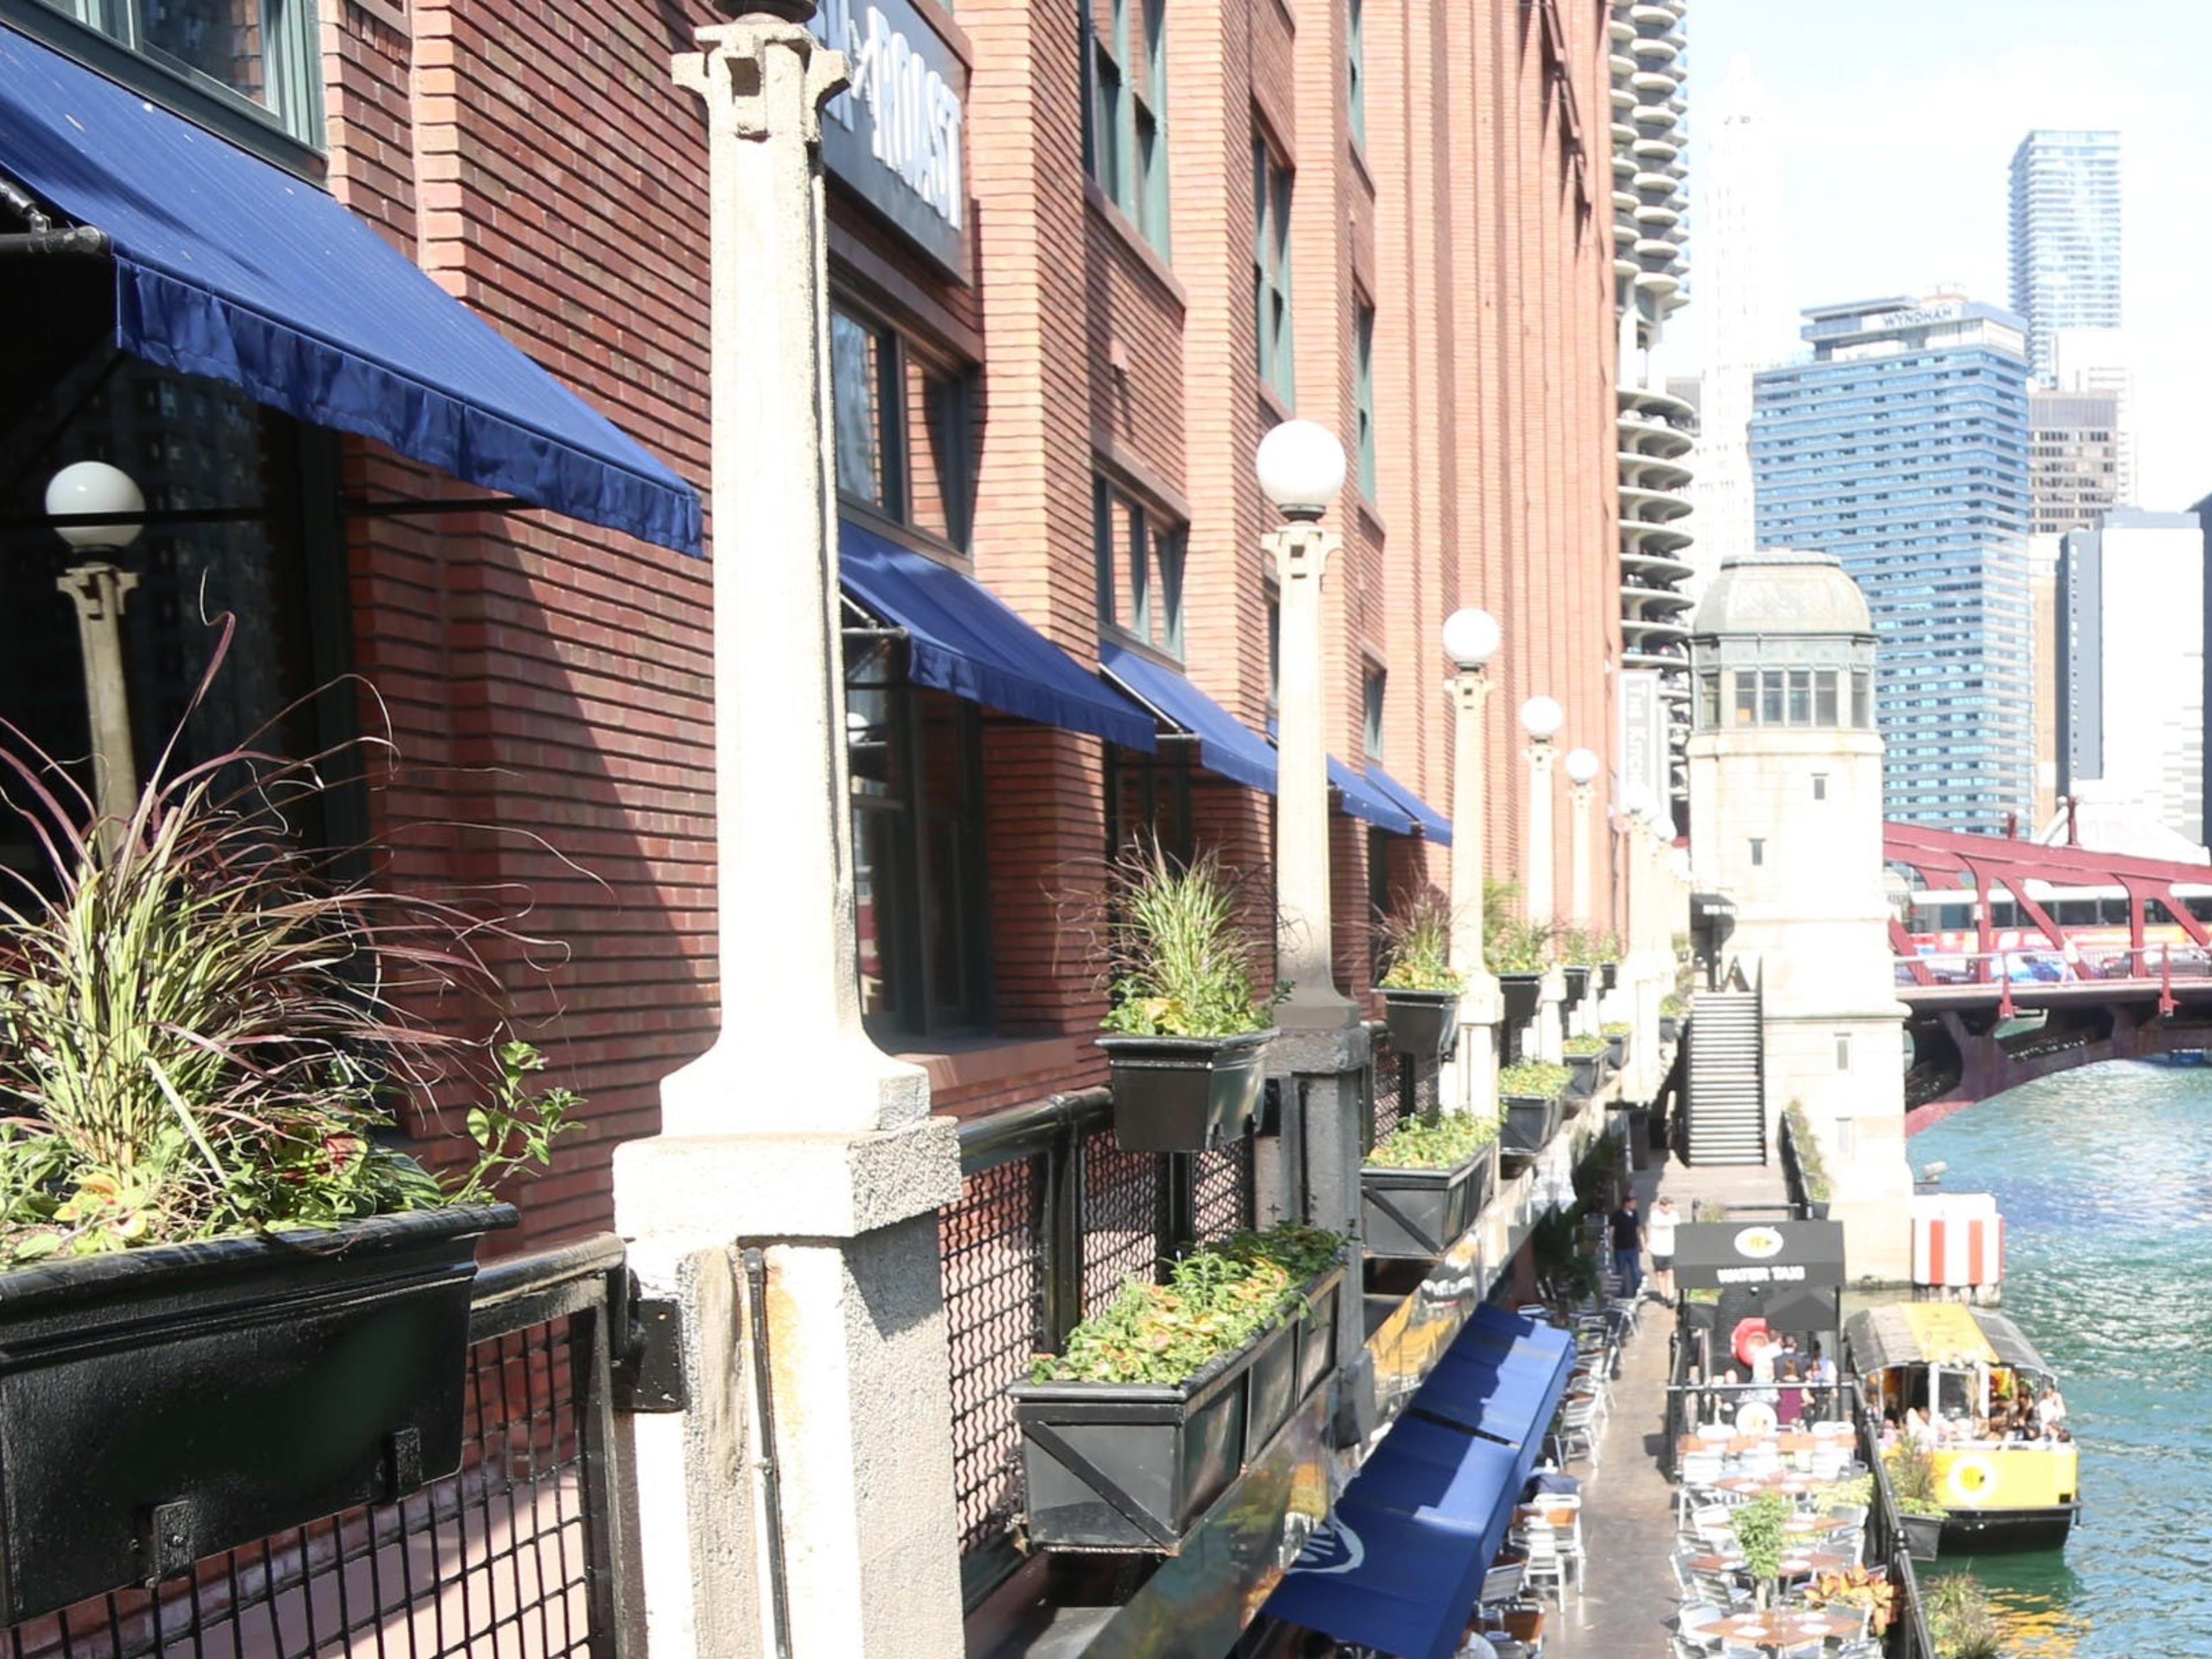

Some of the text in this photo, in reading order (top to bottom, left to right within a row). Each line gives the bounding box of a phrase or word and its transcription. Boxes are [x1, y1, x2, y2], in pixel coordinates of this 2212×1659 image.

[867, 5, 963, 232] ROAST
[1882, 308, 1952, 327] WYNDHAM
[1717, 1266, 1805, 1283] WATER TAXI
